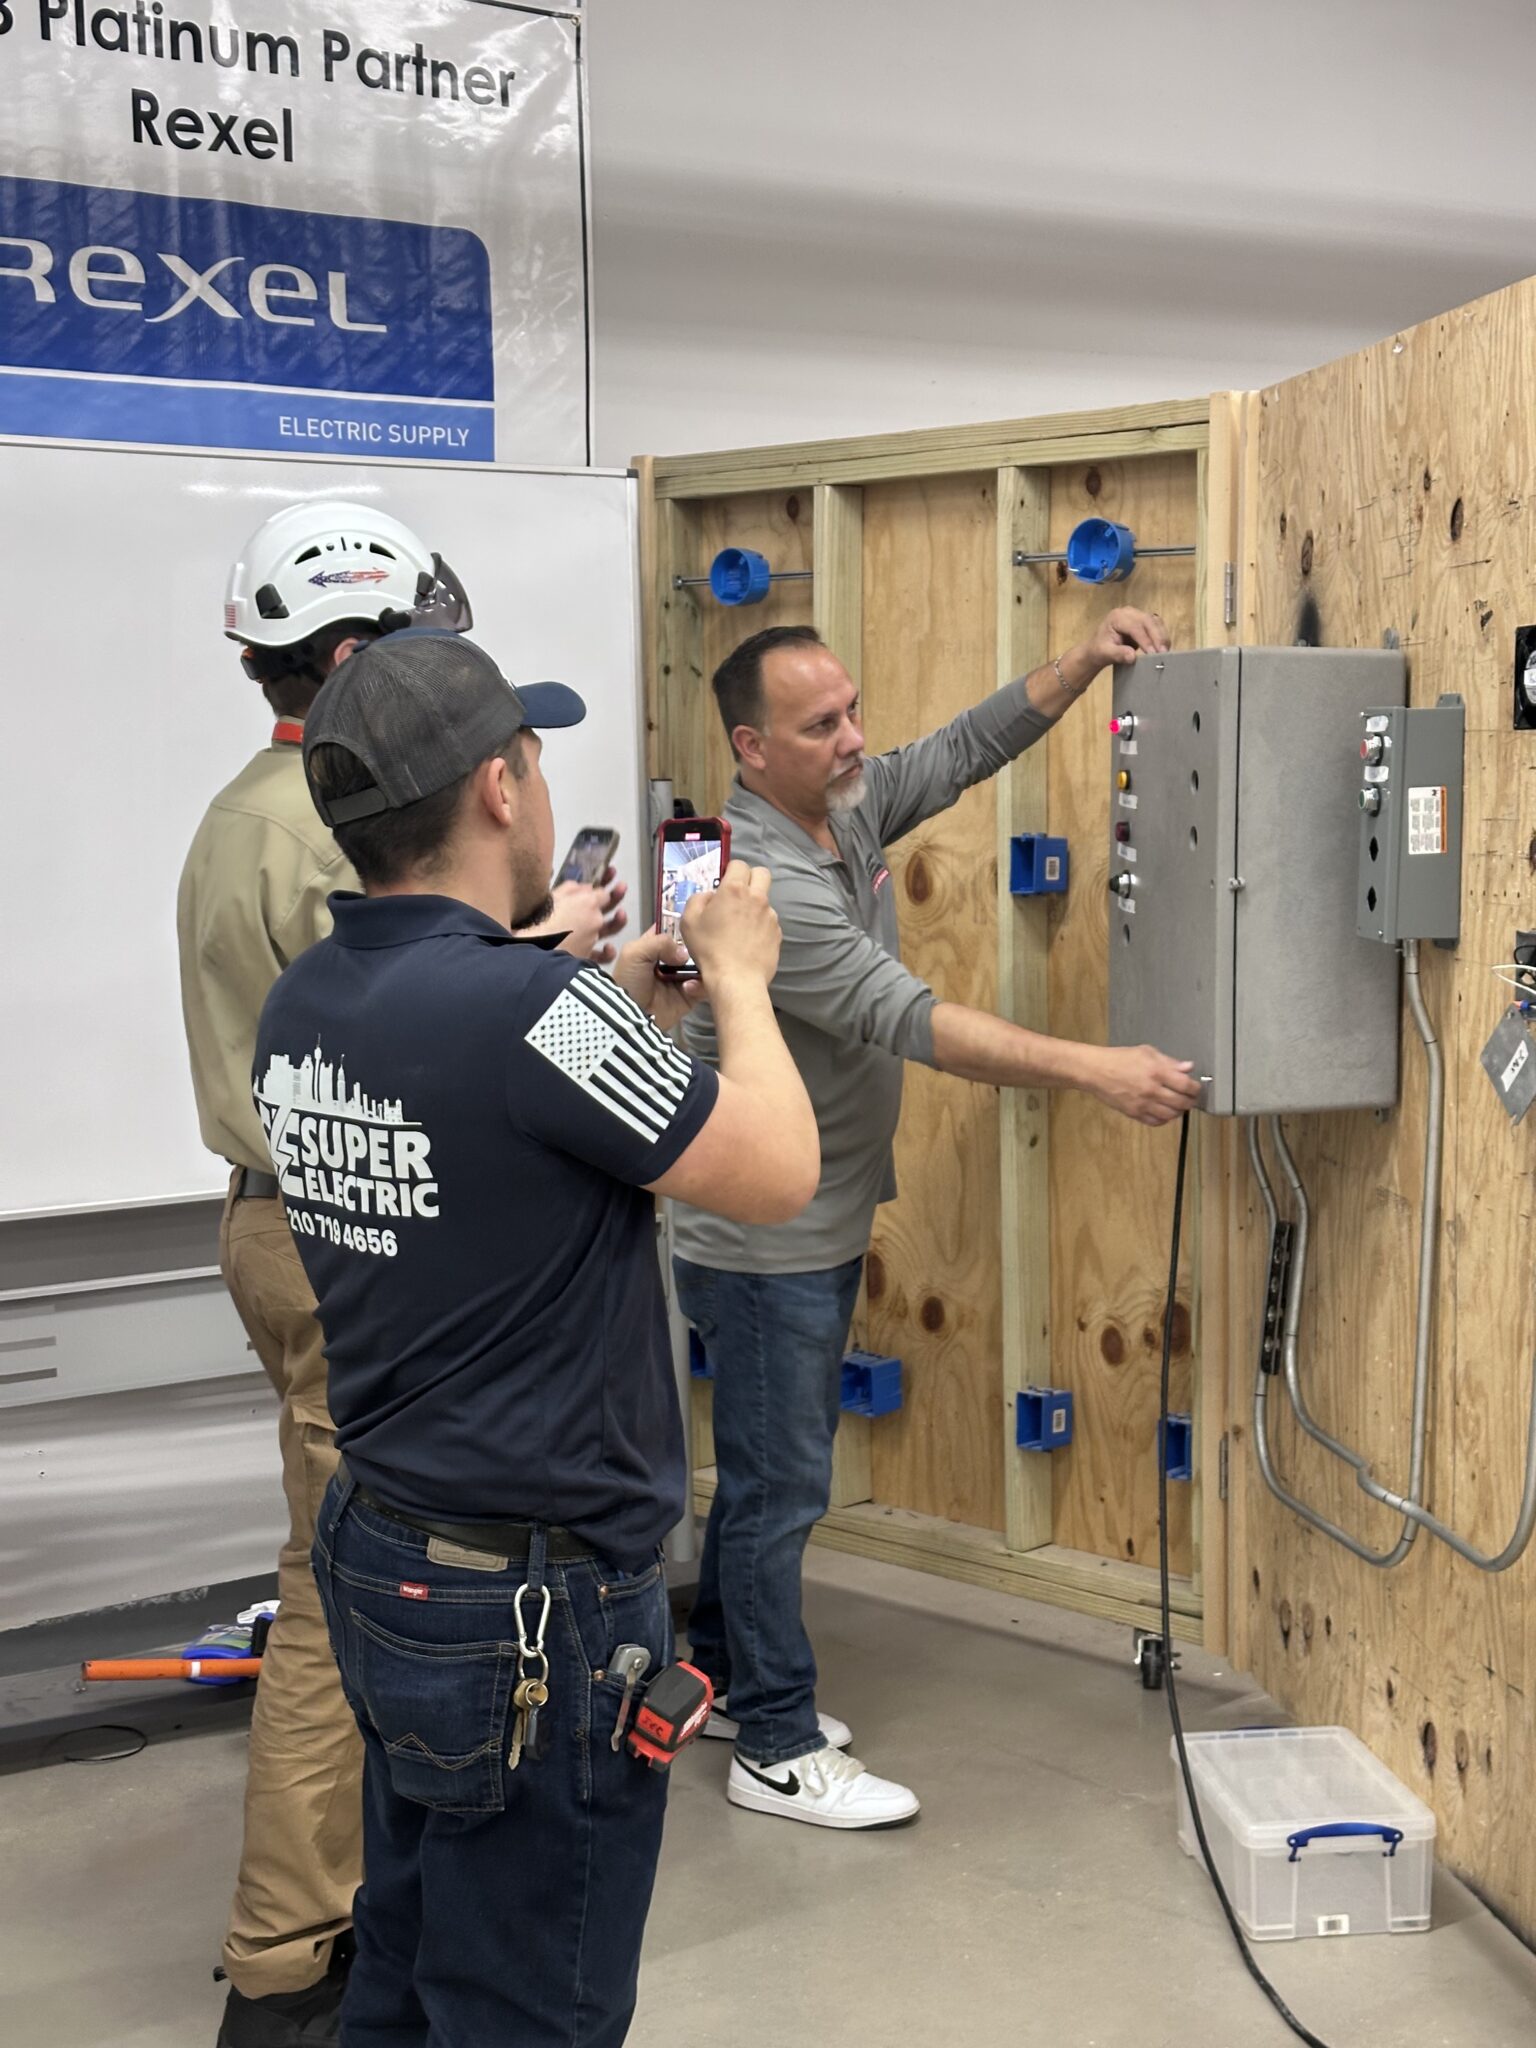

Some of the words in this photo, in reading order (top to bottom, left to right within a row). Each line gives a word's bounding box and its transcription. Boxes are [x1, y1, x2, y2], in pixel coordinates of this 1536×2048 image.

[39, 0, 300, 77] Platinum
[322, 29, 516, 108] Partner
[131, 87, 295, 162] Rexel
[279, 415, 382, 442] ELECTRIC
[388, 424, 470, 447] SUPPLY
[300, 1116, 434, 1179] SUPER
[304, 1166, 440, 1218] ELECTRIC
